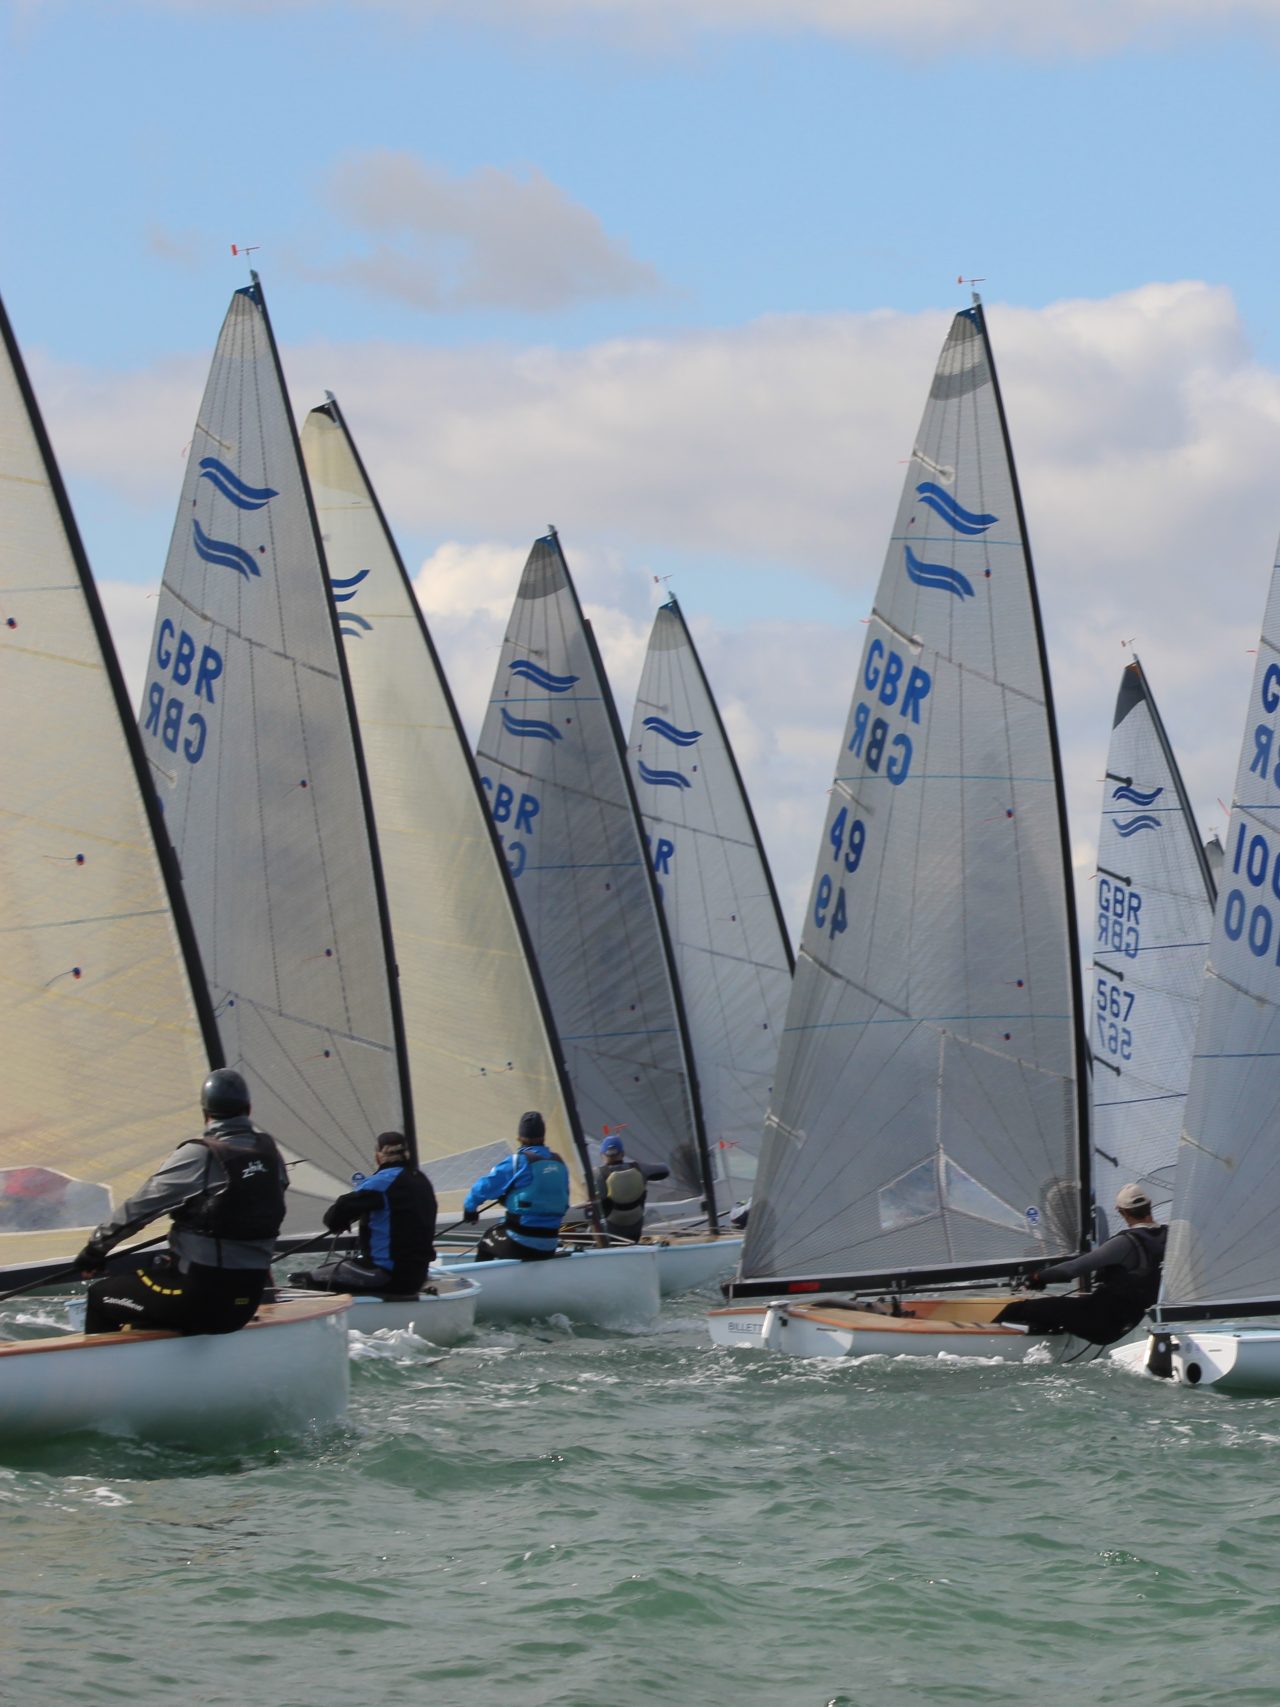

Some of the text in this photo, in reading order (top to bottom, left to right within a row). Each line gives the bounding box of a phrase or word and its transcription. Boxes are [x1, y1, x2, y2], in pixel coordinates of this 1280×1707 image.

[157, 618, 223, 704] GBR
[864, 638, 932, 724] GBR
[829, 806, 866, 873] 49
[1098, 878, 1142, 926] GBR
[1097, 978, 1135, 1023] 567
